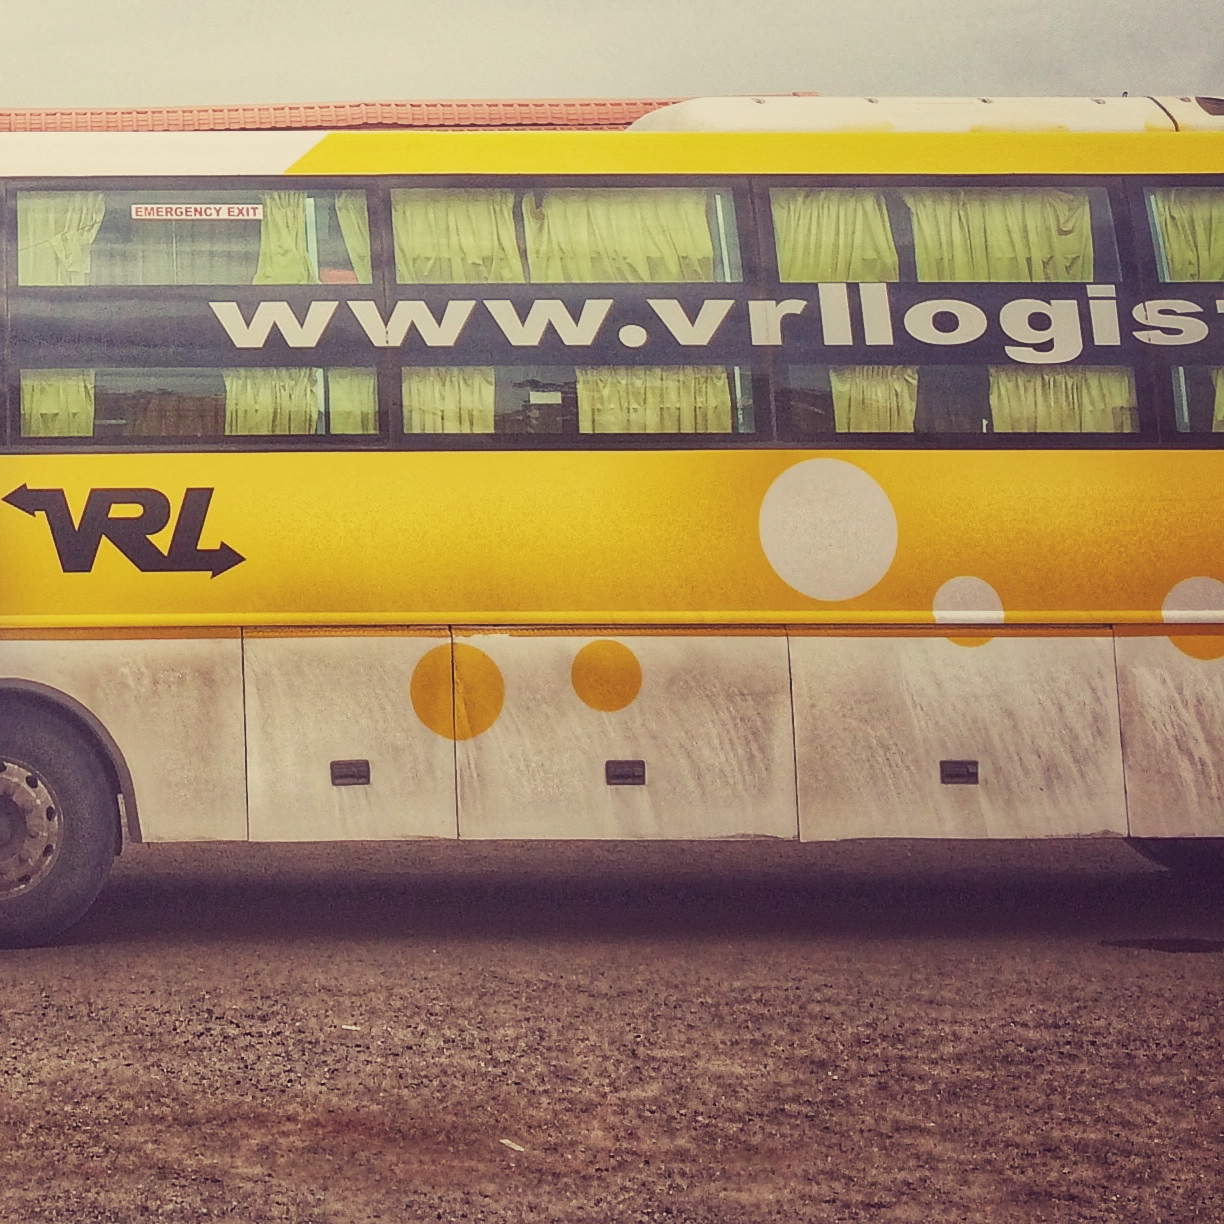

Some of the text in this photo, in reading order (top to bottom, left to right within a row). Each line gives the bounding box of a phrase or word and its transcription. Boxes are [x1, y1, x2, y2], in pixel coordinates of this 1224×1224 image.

[135, 206, 259, 217] EMERGENCY EXIT
[209, 283, 1224, 363] www.vrllogis
[2, 484, 246, 578] VRL
